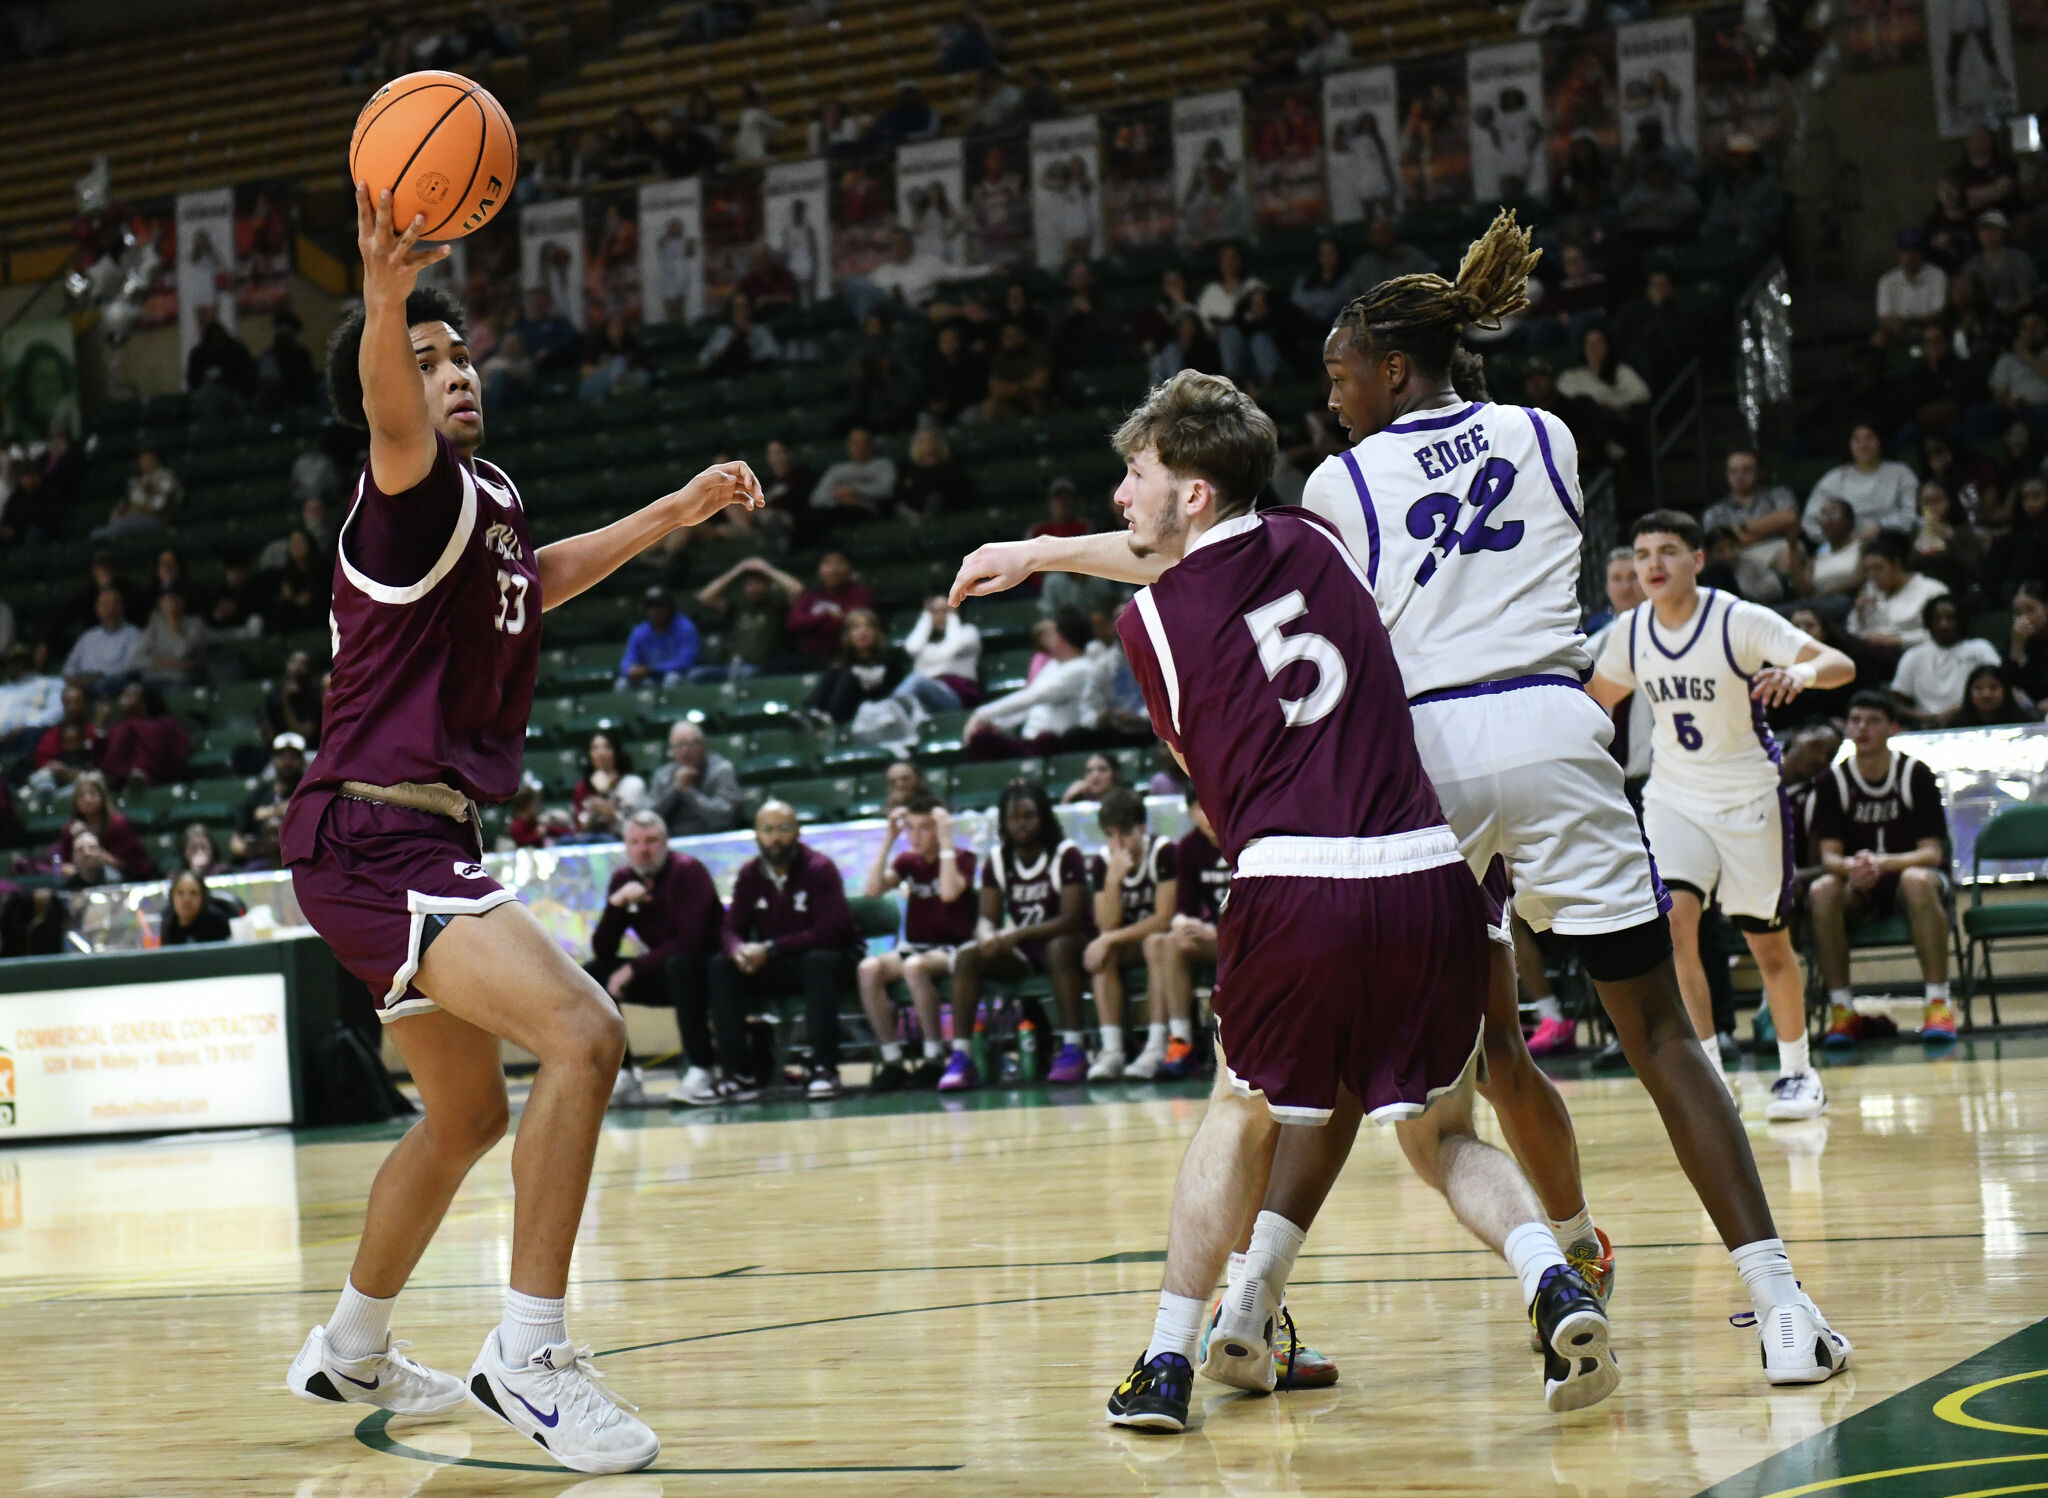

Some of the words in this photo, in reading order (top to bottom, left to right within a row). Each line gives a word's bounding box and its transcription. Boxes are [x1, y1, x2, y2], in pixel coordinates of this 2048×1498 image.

[1413, 424, 1489, 480] EDGE
[1406, 457, 1525, 587] 32
[1243, 589, 1348, 727] 5
[1673, 712, 1703, 751] 5
[16, 1026, 107, 1051] COMMERCIAL
[111, 1020, 177, 1045] GENERAL
[181, 1012, 278, 1040] CONTRACTOR
